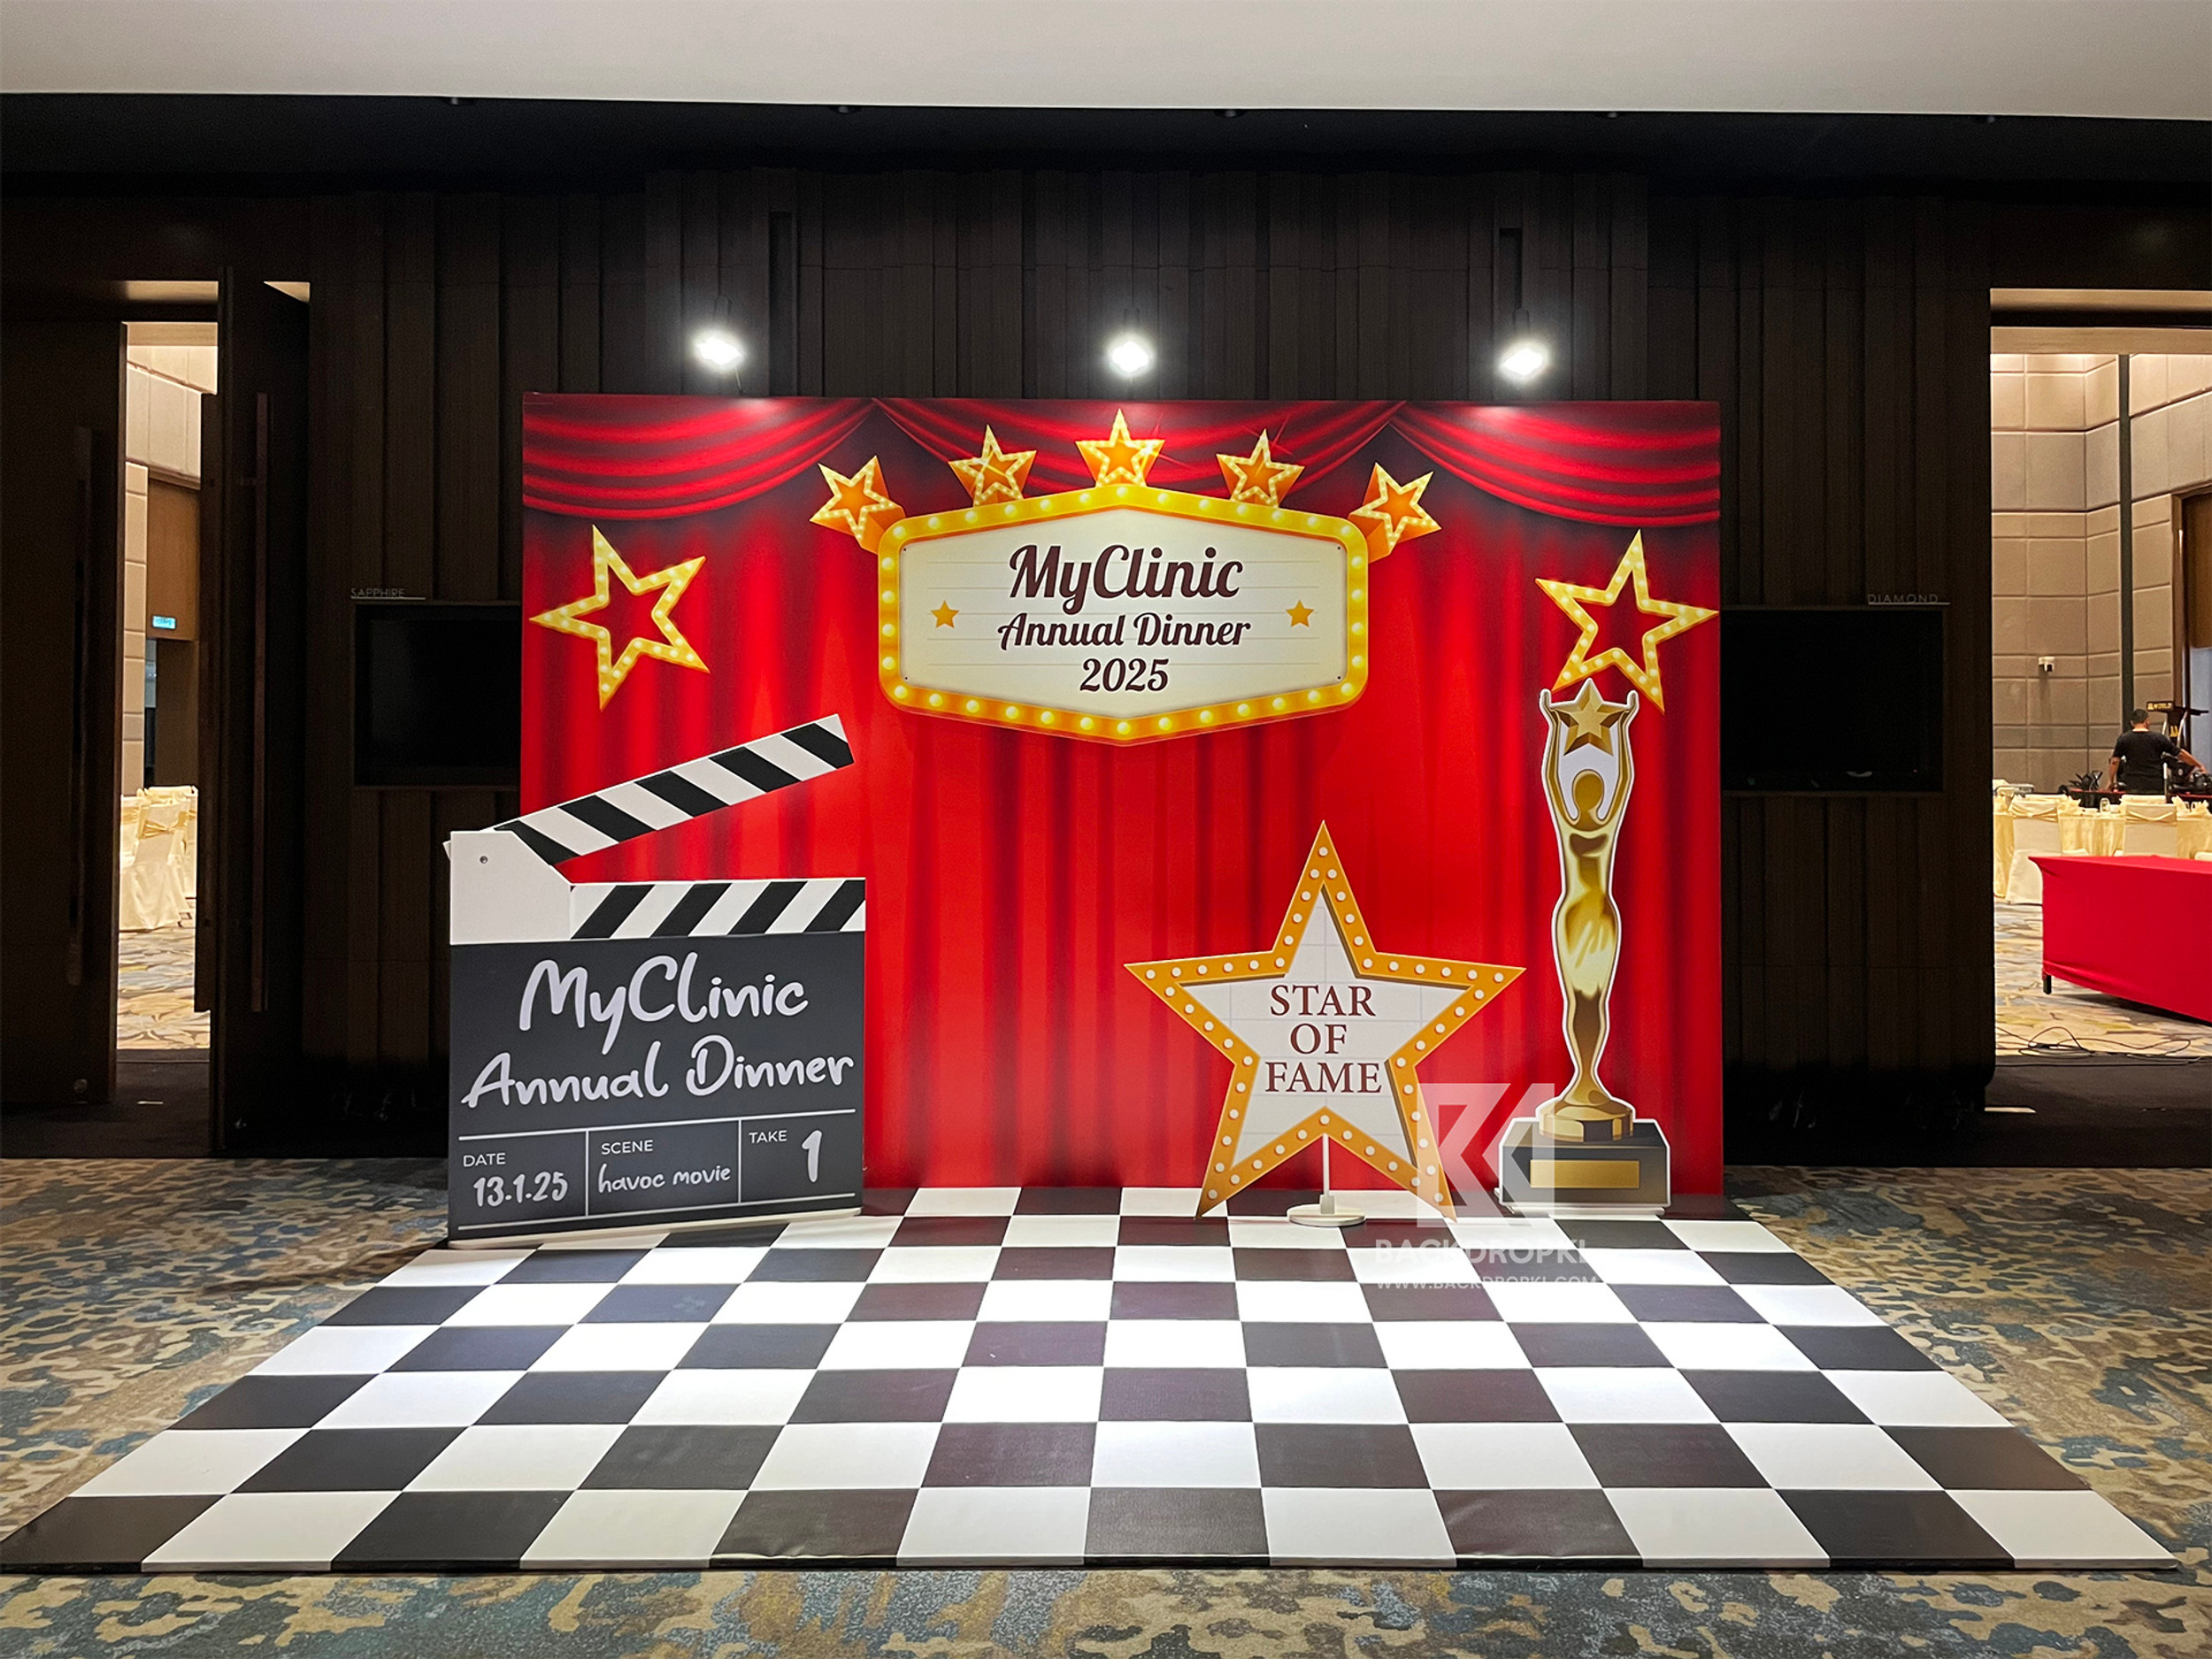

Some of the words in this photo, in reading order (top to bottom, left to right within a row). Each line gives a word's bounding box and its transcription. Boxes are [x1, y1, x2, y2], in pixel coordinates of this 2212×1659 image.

[350, 588, 405, 598] SAPPHIRE
[1010, 544, 1243, 614] MyClinic
[1867, 594, 1939, 603] DIAMOND
[997, 612, 1124, 650] Annual
[1133, 612, 1250, 647] Dinner
[1079, 657, 1169, 692] 2025
[518, 951, 809, 1056] MyClinic
[1270, 984, 1376, 1018] STAR
[1290, 1023, 1347, 1055] OF
[461, 1041, 669, 1109] Annual
[686, 1034, 854, 1097] Dinner
[1264, 1062, 1382, 1094] FAME
[601, 1139, 654, 1155] SCENE
[749, 1130, 787, 1143] TAKE
[463, 1152, 506, 1167] DATE
[802, 1130, 823, 1182] 1
[473, 1171, 568, 1208] 13.1.25
[598, 1164, 665, 1194] havoc
[673, 1164, 732, 1188] movie
